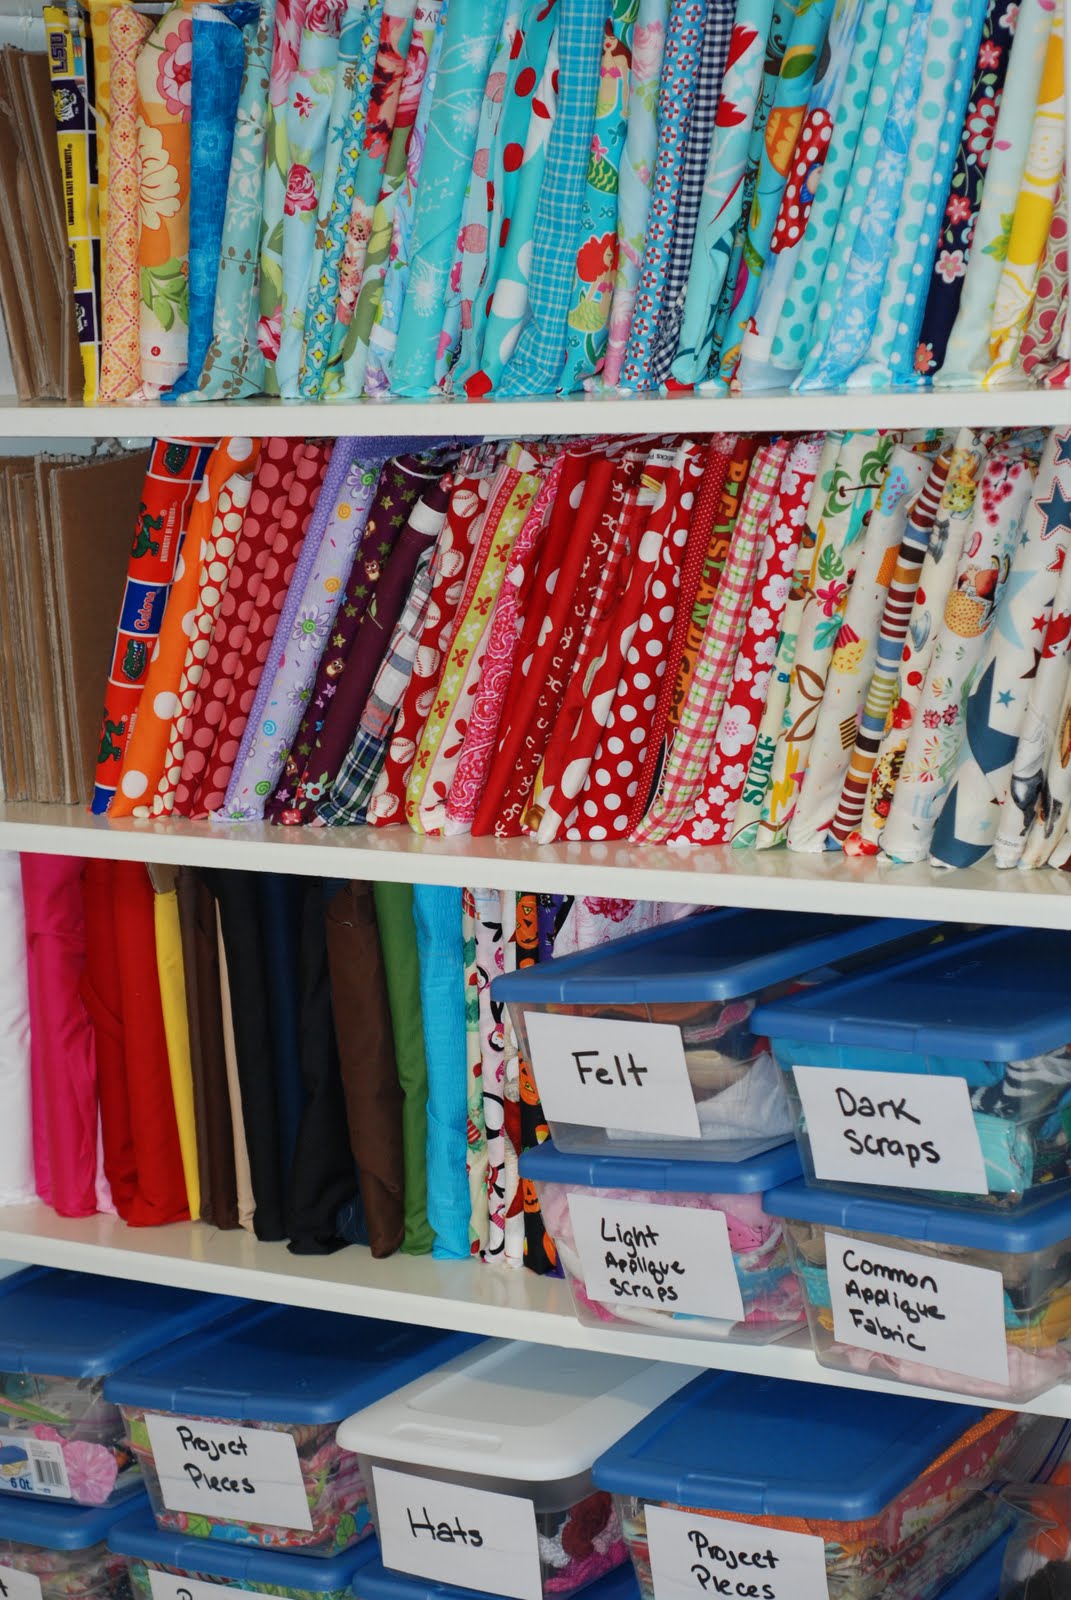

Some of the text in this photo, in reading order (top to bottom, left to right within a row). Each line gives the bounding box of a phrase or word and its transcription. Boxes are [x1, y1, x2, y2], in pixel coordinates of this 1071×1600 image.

[50, 33, 68, 73] LSU
[64, 149, 73, 179] UNIVERSITY
[134, 591, 156, 630] Gators
[741, 734, 776, 806] SURF
[571, 1051, 648, 1087] Felt
[835, 1087, 921, 1125] Dark
[601, 1217, 660, 1258] Light
[842, 1249, 938, 1293] Common
[845, 1279, 946, 1323] Applique
[849, 1308, 926, 1351] Fabric
[176, 1425, 249, 1461] Project
[10, 1477, 18, 1488] 6
[184, 1463, 256, 1494] Pieces
[407, 1507, 483, 1547] Hats
[687, 1530, 780, 1570] Project
[691, 1564, 776, 1600] Pieces
